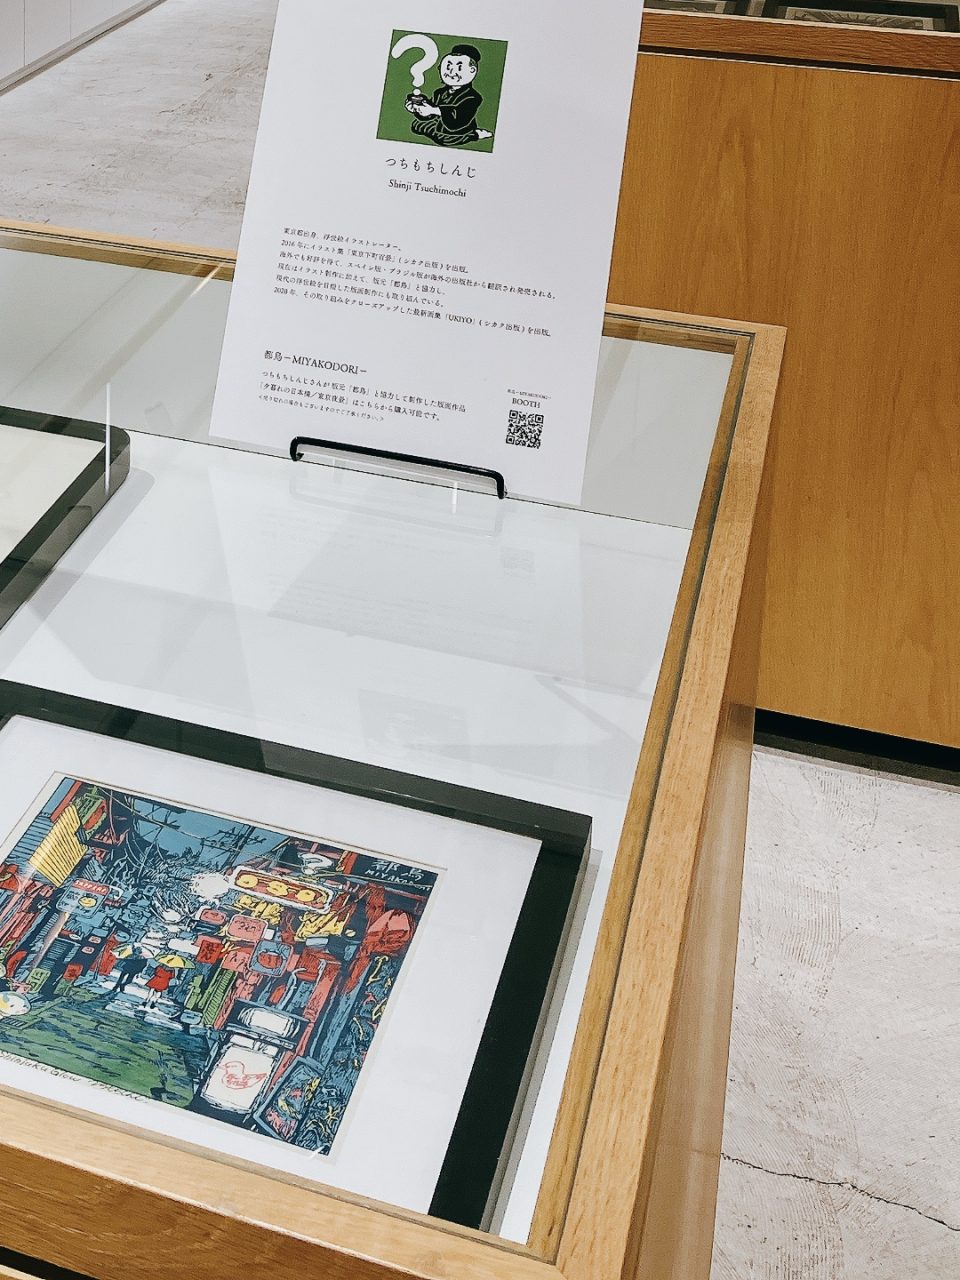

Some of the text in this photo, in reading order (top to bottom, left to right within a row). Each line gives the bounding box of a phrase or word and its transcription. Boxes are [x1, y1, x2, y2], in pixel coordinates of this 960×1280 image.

[385, 155, 476, 178] つちもちしんじ
[388, 178, 466, 197] Shinji Tsuchimochi
[512, 397, 540, 408] BOOTH
